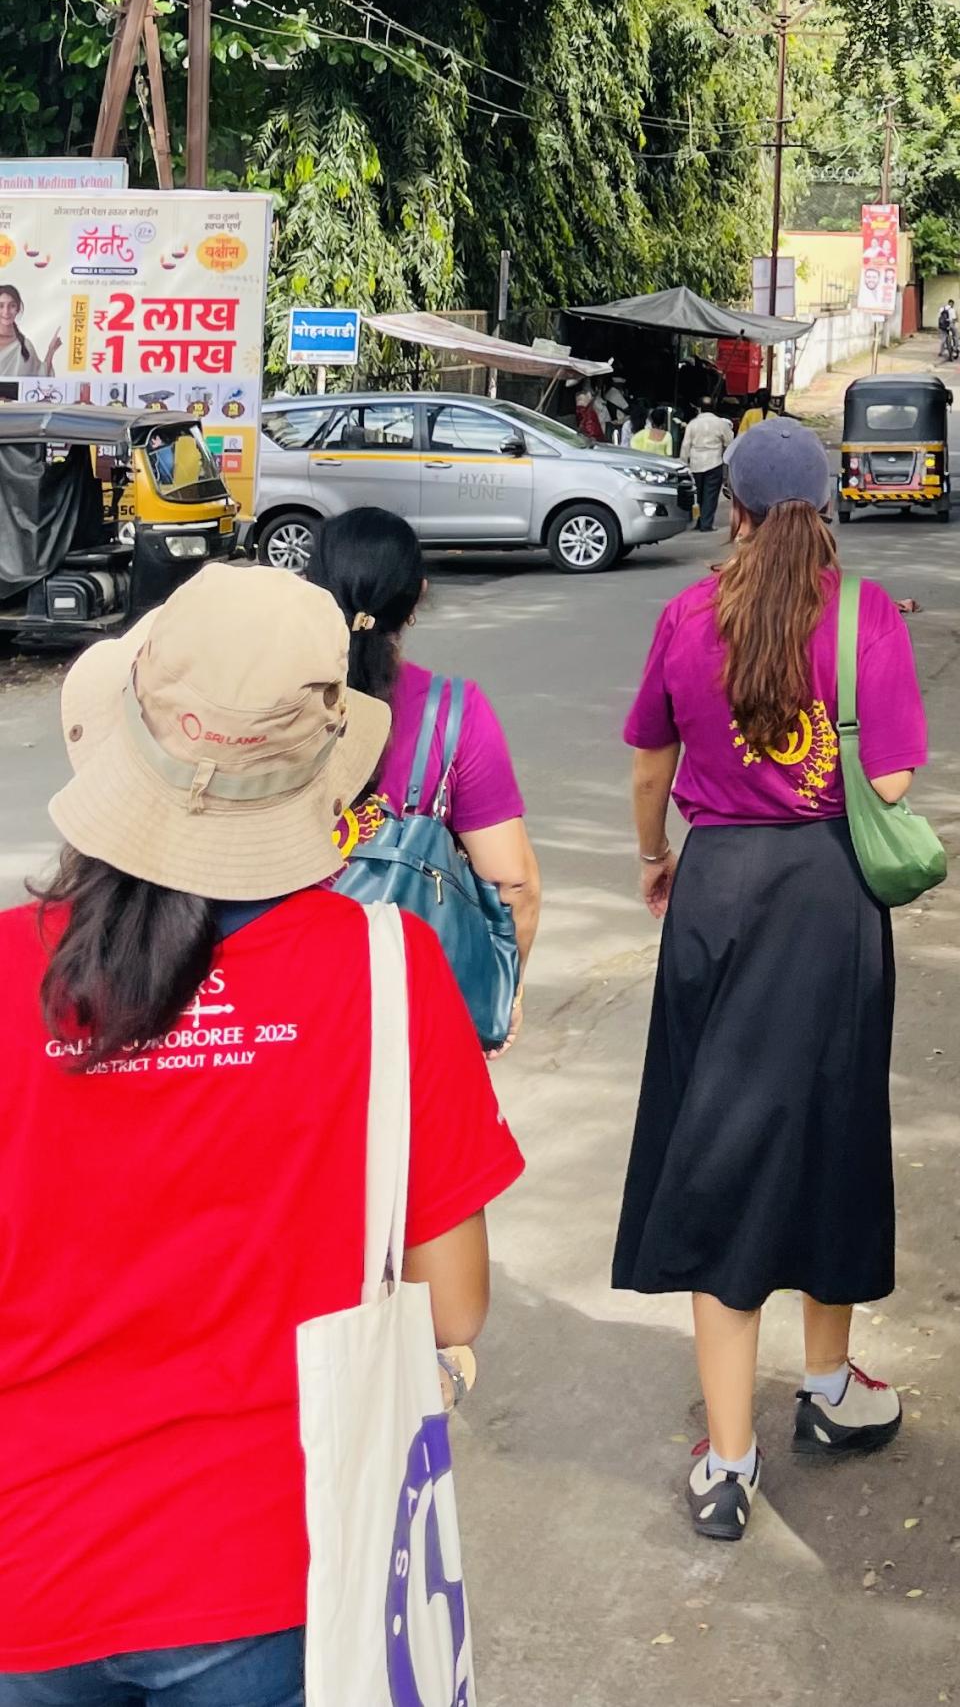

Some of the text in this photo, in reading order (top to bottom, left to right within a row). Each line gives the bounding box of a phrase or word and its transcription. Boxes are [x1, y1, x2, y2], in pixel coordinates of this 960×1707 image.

[76, 225, 134, 262] कॉर्नर
[94, 293, 240, 331] ₹2 लाख
[294, 319, 355, 339] मोहनवाडी
[91, 336, 237, 373] ₹1 लाख
[459, 472, 506, 485] HYATT
[458, 486, 506, 500] PUNE
[254, 1023, 298, 1042] 2025
[156, 1054, 206, 1070] SCOUT
[213, 1050, 256, 1066] RALLY
